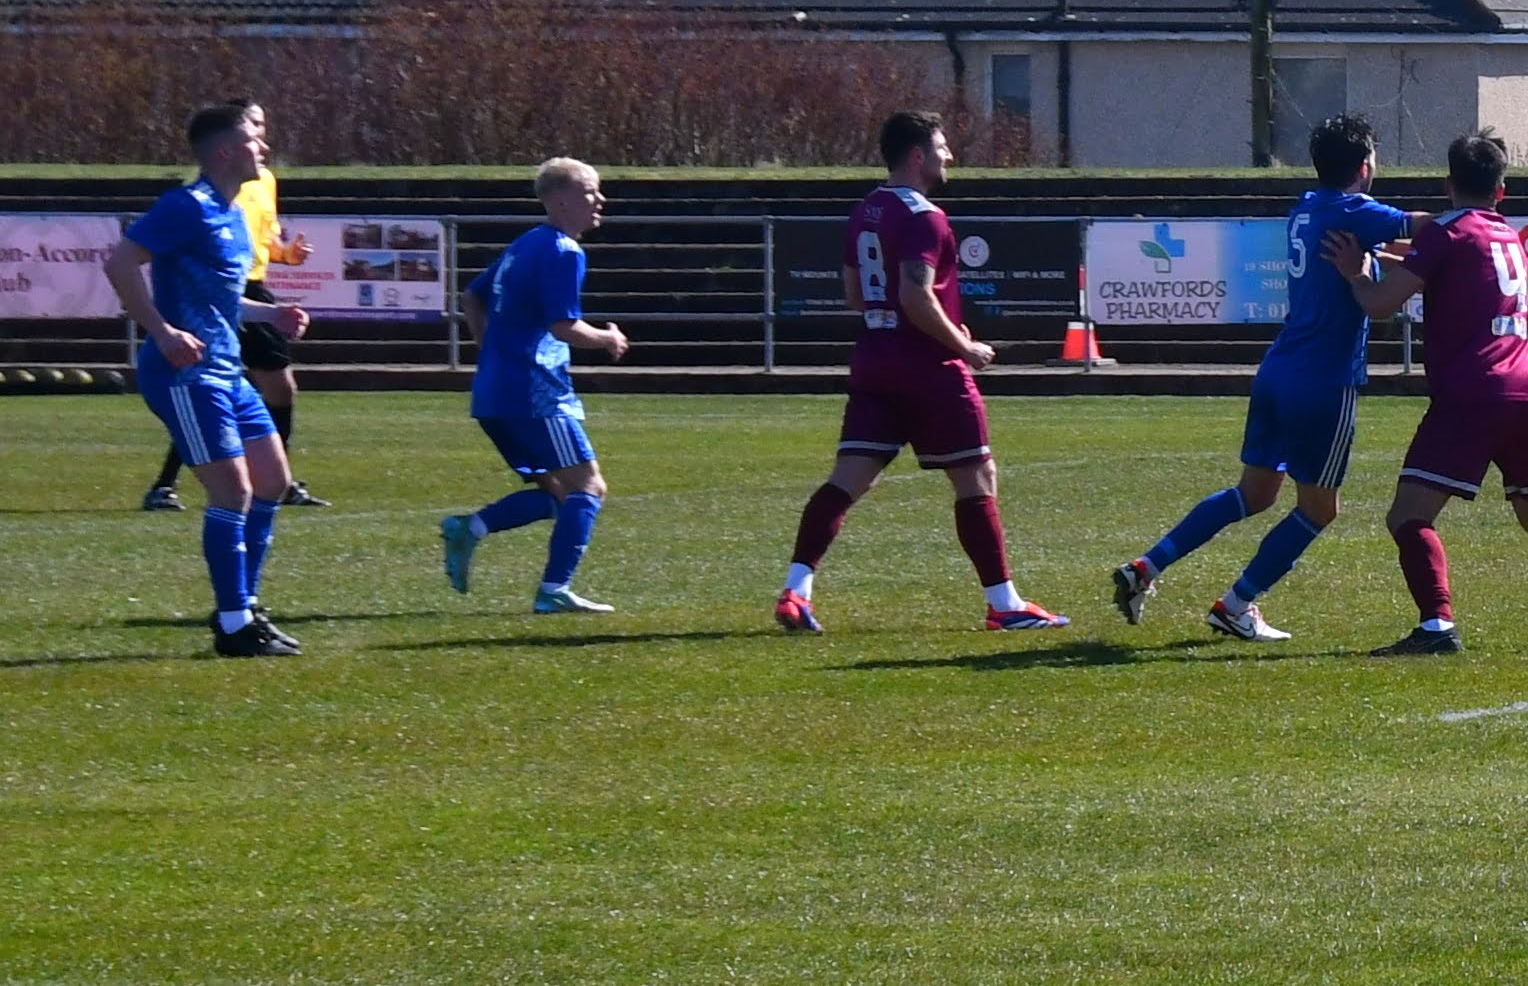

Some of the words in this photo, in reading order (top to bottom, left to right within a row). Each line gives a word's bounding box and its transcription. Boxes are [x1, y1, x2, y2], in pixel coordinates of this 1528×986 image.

[857, 231, 887, 302] 8
[1288, 213, 1310, 278] 5
[0, 272, 32, 292] ub
[1099, 280, 1227, 299] CRAWFORDS
[1490, 242, 1528, 313] 4
[1106, 301, 1220, 320] PHARMACY
